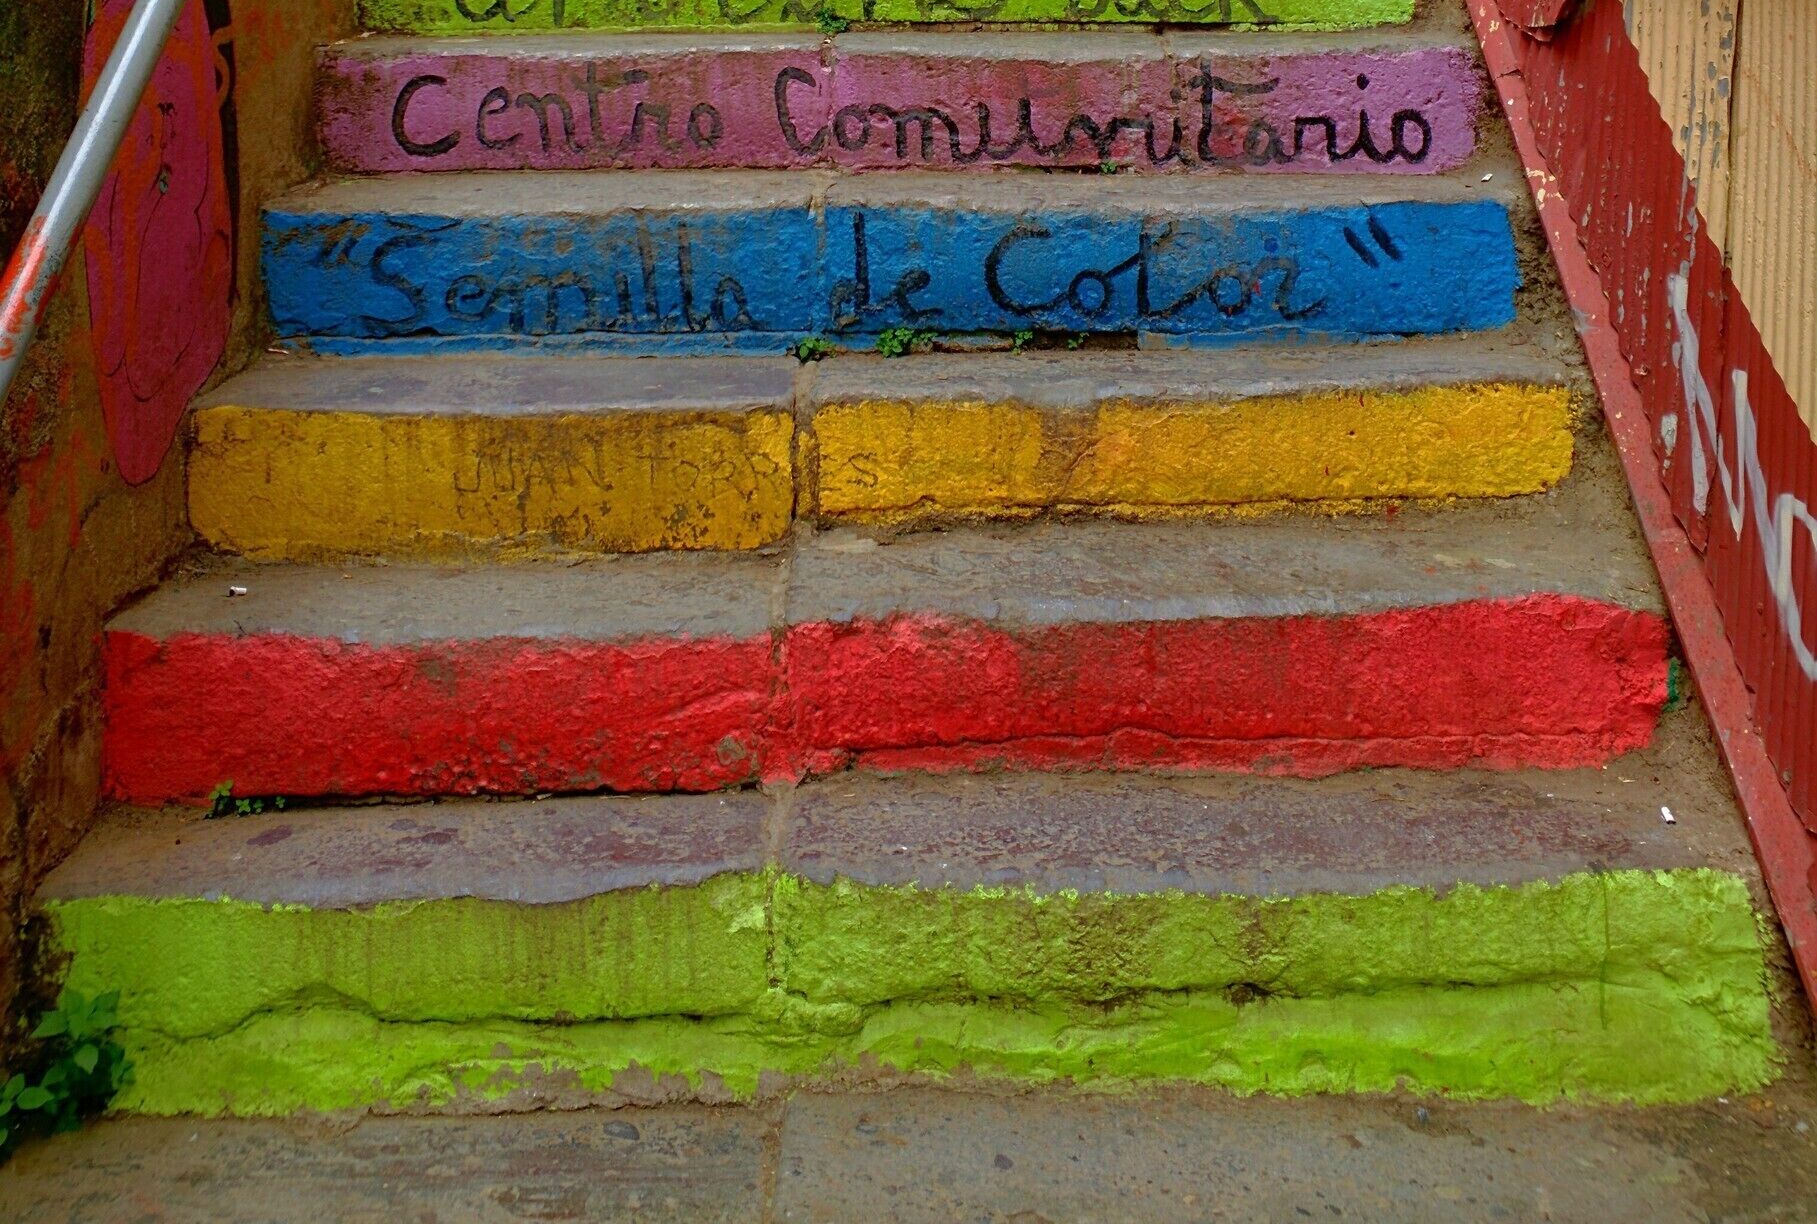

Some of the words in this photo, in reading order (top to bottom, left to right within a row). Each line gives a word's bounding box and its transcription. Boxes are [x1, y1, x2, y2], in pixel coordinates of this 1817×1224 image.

[391, 60, 724, 158] Centro
[774, 56, 1432, 167] Comunitario
[829, 210, 948, 331] de
